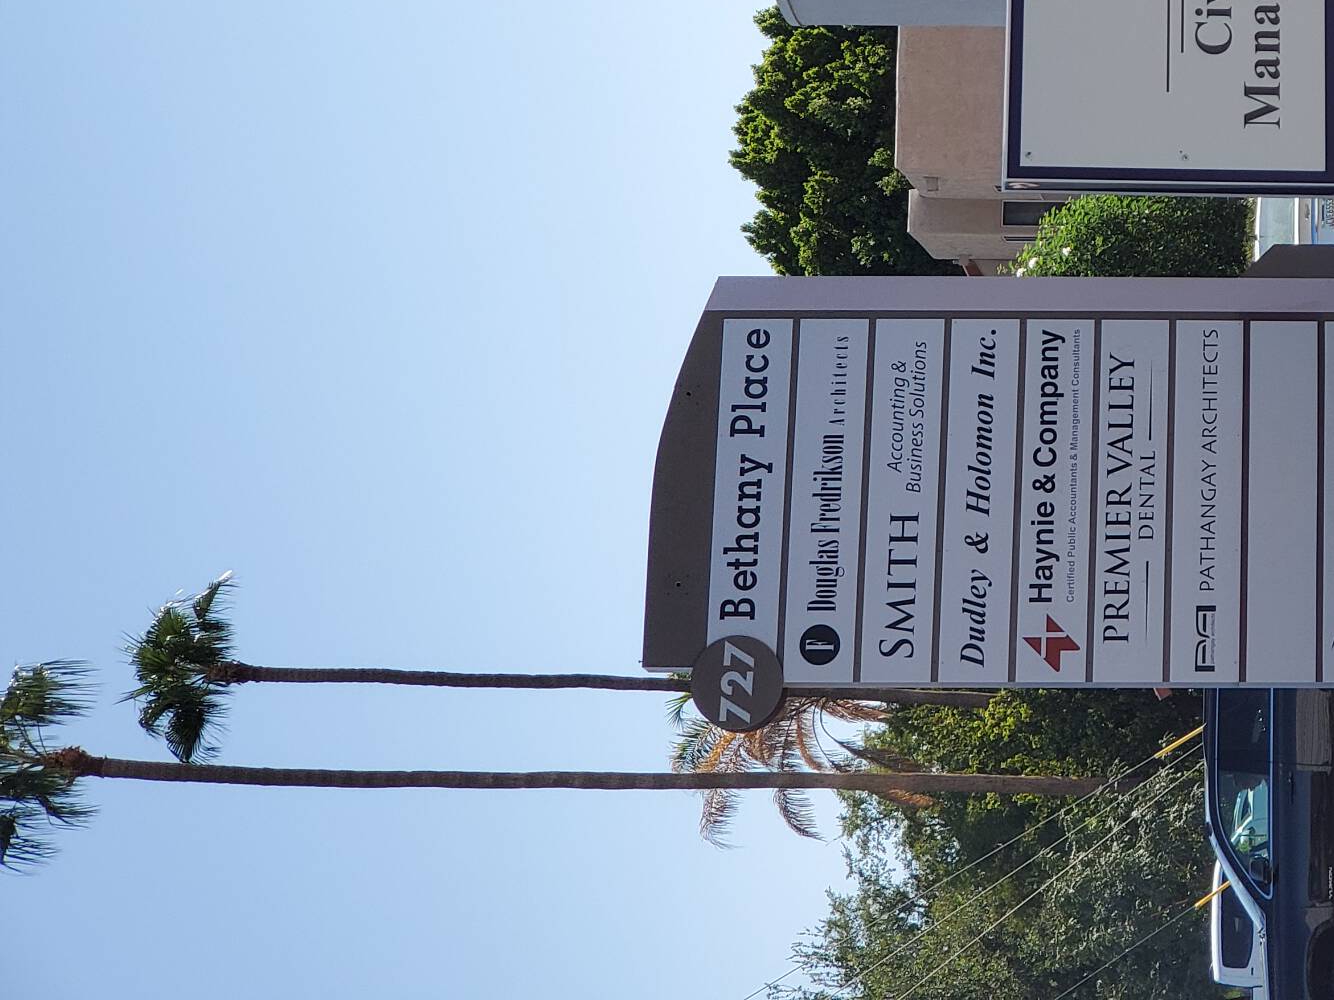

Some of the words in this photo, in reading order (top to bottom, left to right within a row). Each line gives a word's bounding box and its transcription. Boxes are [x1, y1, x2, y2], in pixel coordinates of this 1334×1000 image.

[730, 329, 770, 437] Place
[829, 337, 848, 426] Architects
[891, 361, 906, 373] &
[905, 342, 926, 418] Solutions
[971, 330, 996, 380] Inc.
[1033, 330, 1065, 467] Company
[1071, 329, 1080, 386] Consultants
[1201, 330, 1218, 454] ARCHITECTS
[887, 377, 913, 474] Accounting
[901, 420, 923, 492] Business
[966, 394, 994, 517] Holomon
[1070, 390, 1080, 450] Management
[1070, 453, 1077, 461] &
[1107, 352, 1134, 478] VALLEY
[811, 435, 844, 533] Fredrikson
[1032, 473, 1055, 493] &
[1068, 463, 1079, 524] Accountants
[1138, 451, 1155, 540] DENTAL
[1199, 460, 1216, 590] PATHANGAY
[715, 452, 773, 620] Bethany
[807, 540, 845, 611] Douglas
[964, 532, 988, 553] &
[1029, 501, 1060, 602] Haynie
[1067, 527, 1078, 557] Public
[1103, 482, 1132, 643] PREMIER
[879, 512, 919, 658] SMITH
[960, 569, 992, 668] Dudley
[1065, 560, 1077, 602] Certified
[716, 639, 760, 723] 727
